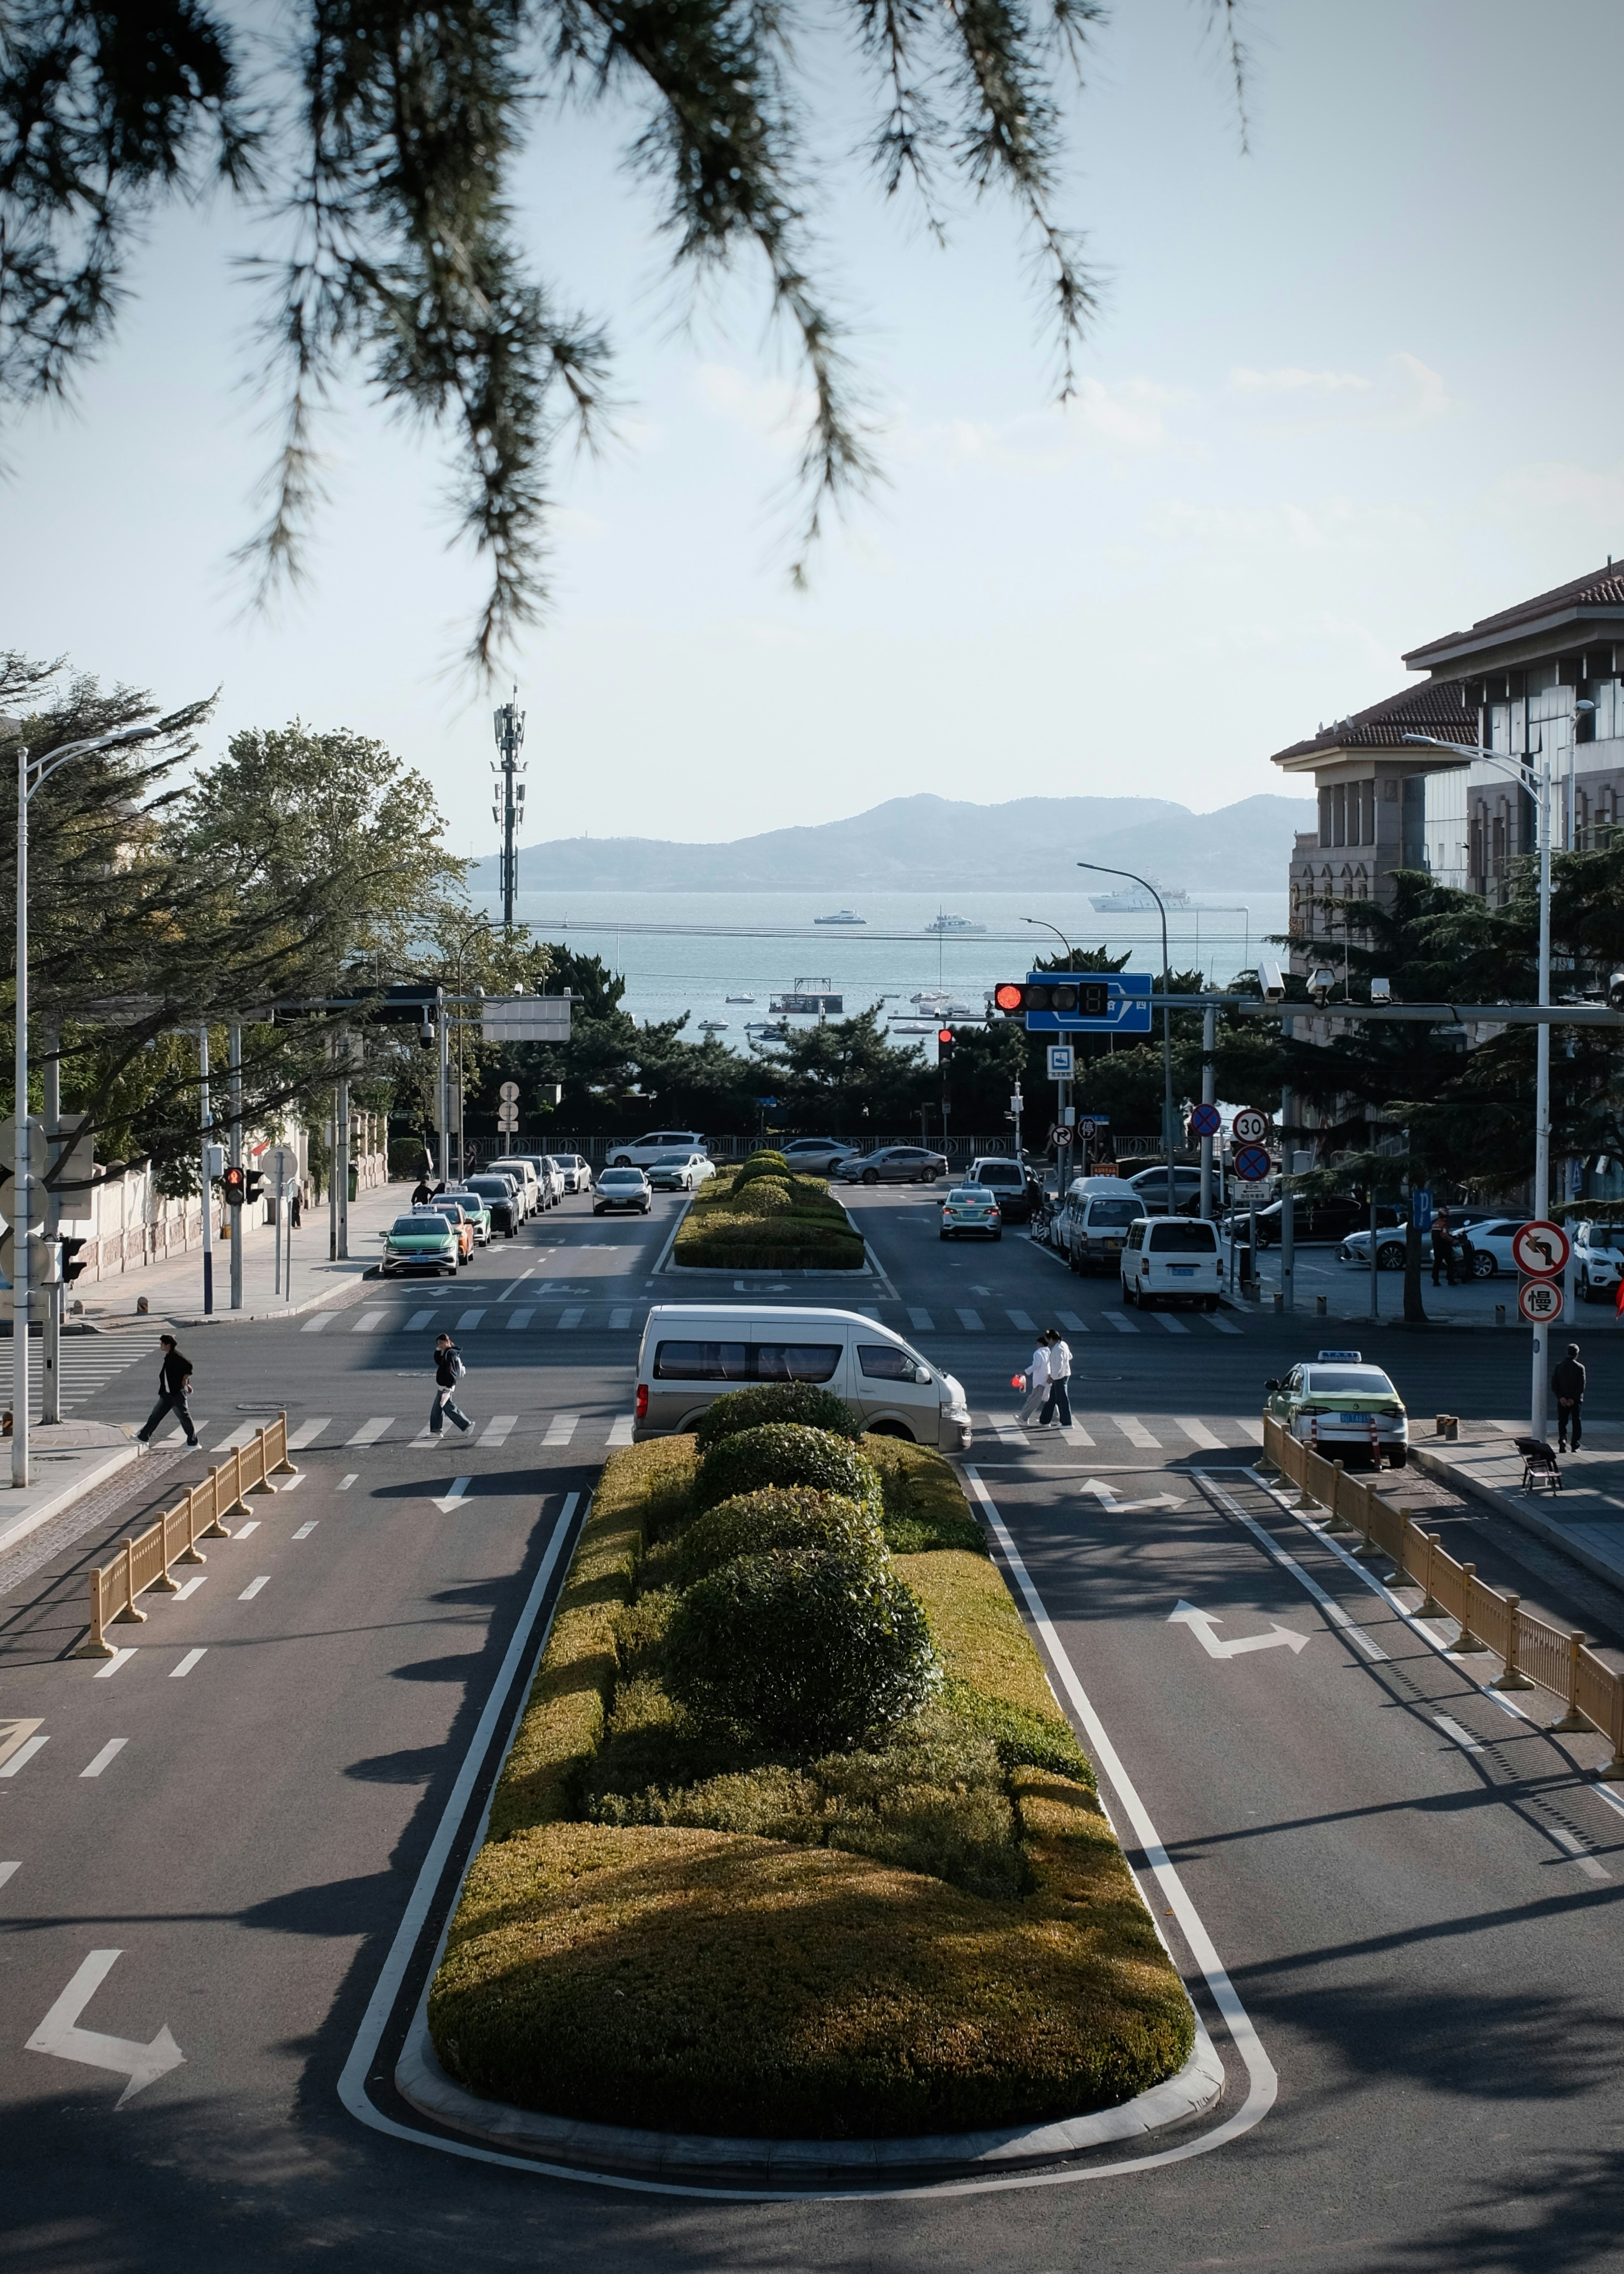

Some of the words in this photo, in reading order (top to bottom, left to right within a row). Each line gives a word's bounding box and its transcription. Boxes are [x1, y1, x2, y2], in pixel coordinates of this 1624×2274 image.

[1081, 1121, 1094, 1136] 停
[1241, 1119, 1261, 1135] 30
[1528, 1290, 1552, 1312] 慢
